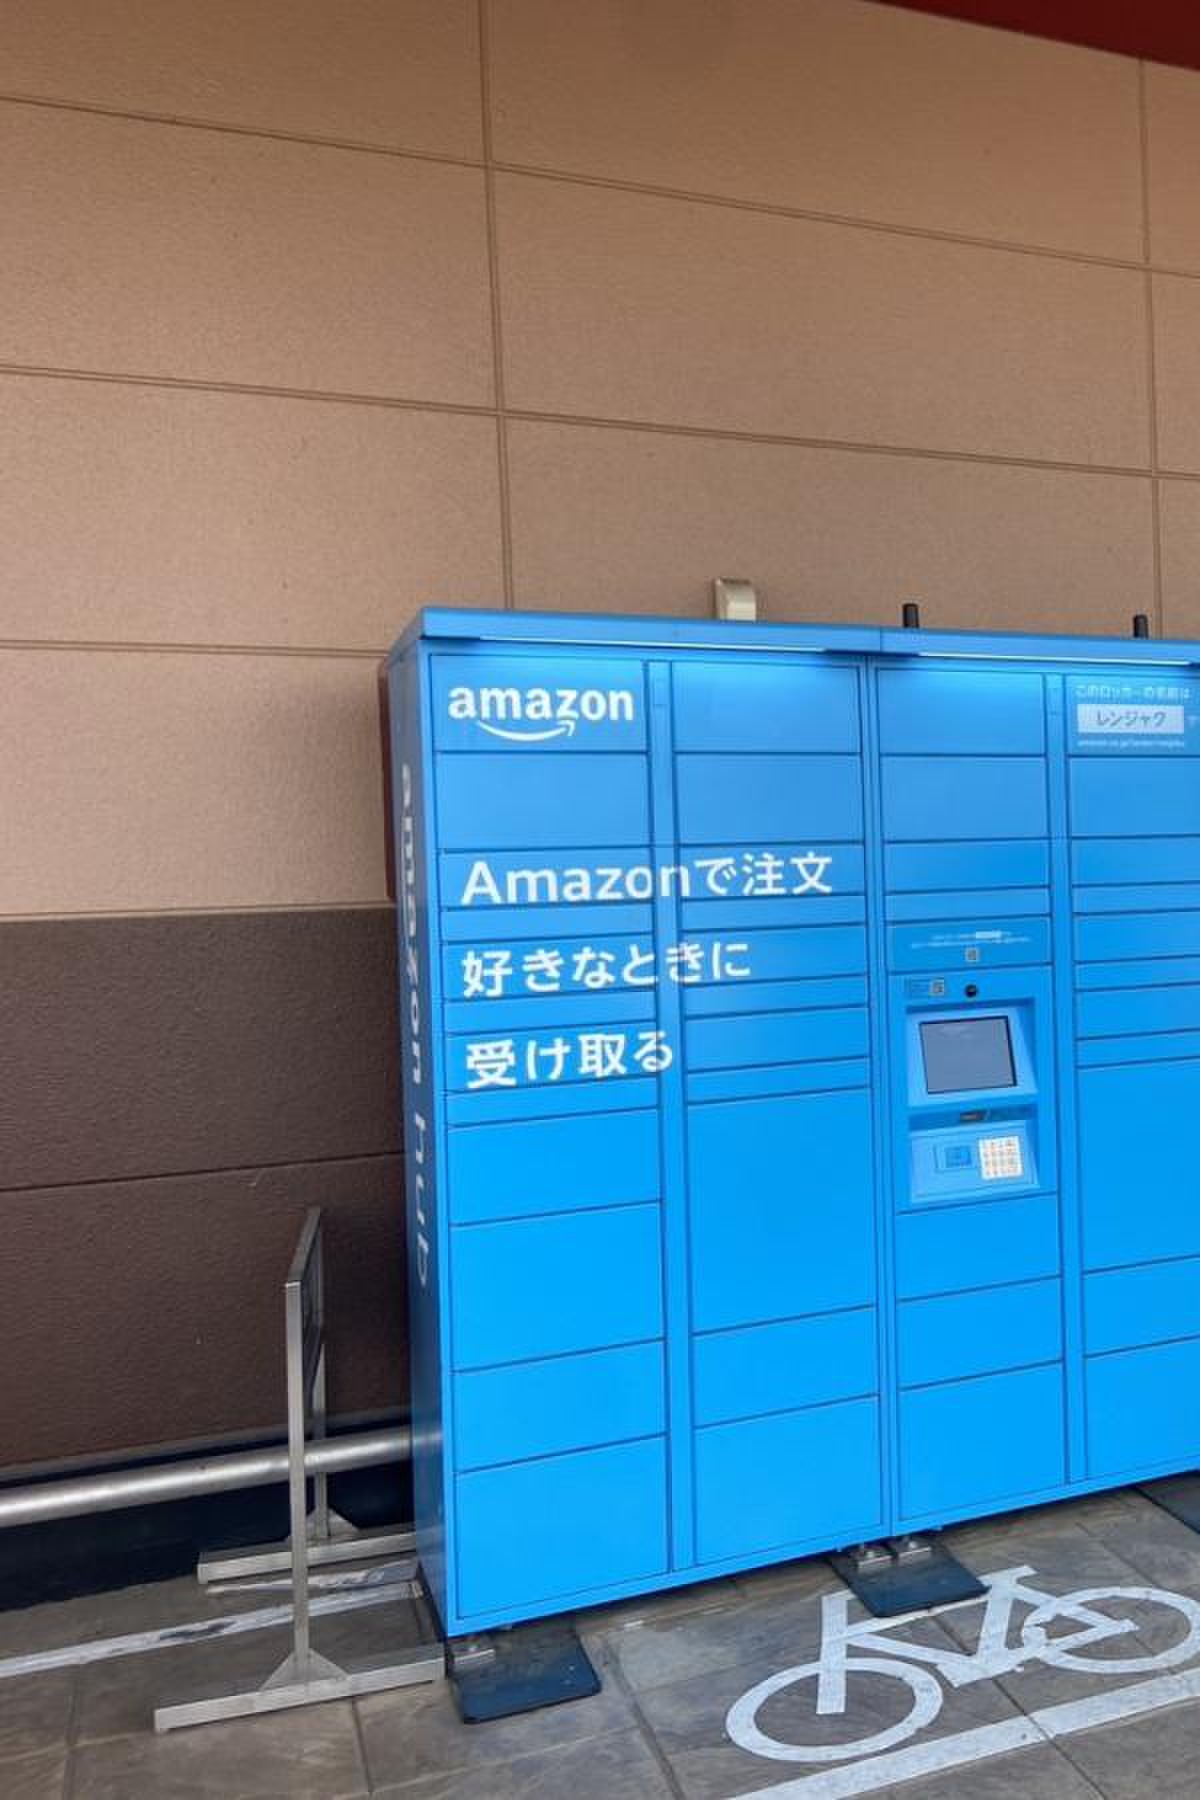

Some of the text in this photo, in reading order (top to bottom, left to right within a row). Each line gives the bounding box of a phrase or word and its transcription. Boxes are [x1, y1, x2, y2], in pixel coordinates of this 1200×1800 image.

[448, 686, 635, 721] amazon
[1096, 709, 1168, 728] レンジャク
[461, 851, 834, 905] Amazonで注文
[462, 942, 752, 998] 好きなときに
[401, 762, 430, 1288] amazon hub
[465, 1030, 673, 1089] 受け取る
